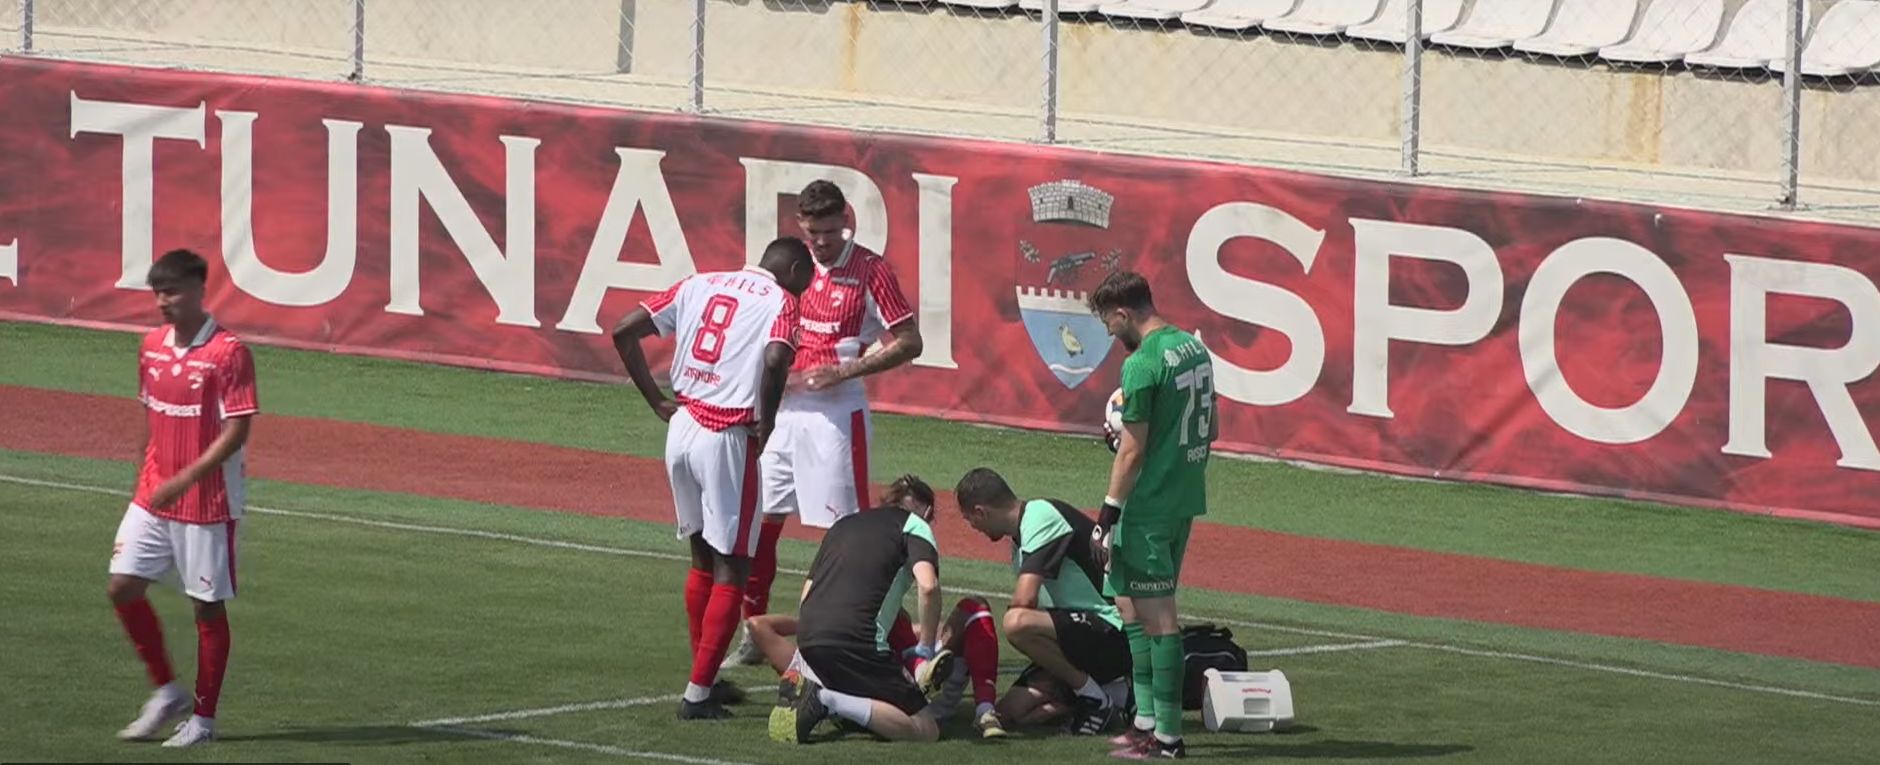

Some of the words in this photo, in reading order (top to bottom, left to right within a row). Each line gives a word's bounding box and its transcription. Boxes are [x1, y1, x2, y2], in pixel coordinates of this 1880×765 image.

[692, 293, 739, 365] 8
[800, 316, 841, 334] PERBET
[1185, 202, 1880, 471] SPOR
[1175, 361, 1214, 447] 73
